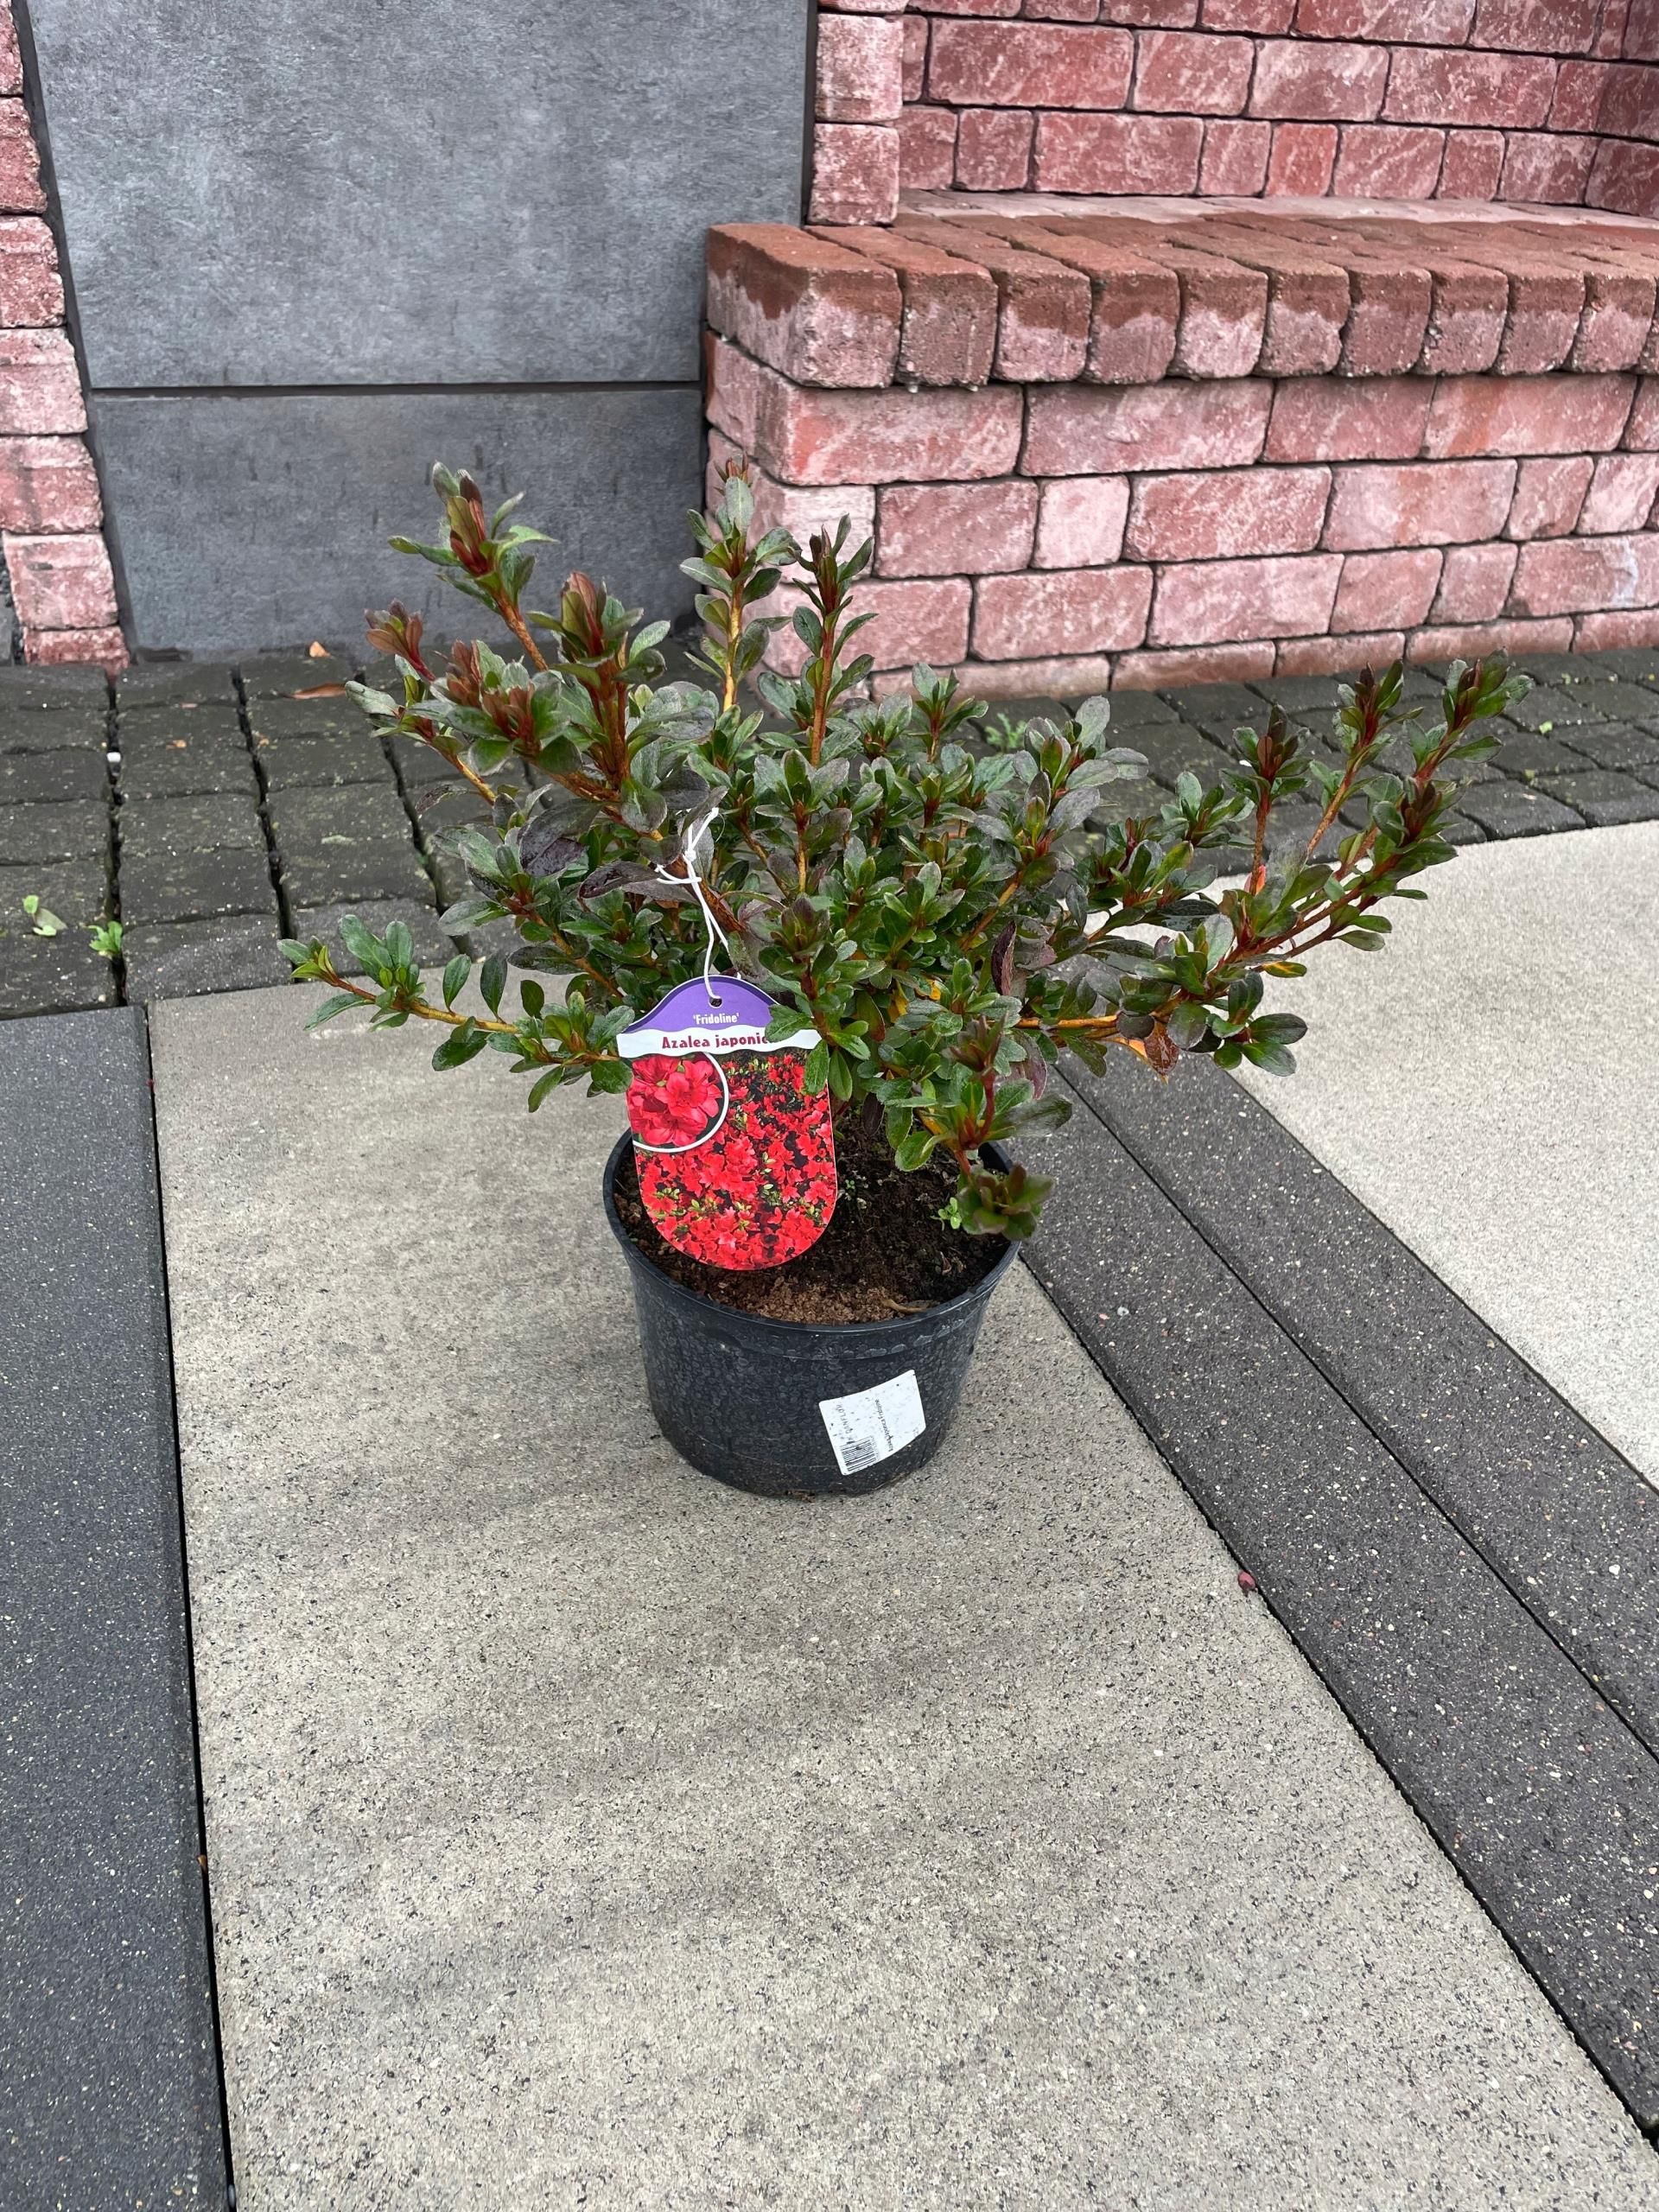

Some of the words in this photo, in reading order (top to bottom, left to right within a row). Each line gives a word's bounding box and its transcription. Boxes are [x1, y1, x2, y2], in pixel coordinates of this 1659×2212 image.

[693, 1013, 740, 1025] 'Fridoline'
[662, 1036, 710, 1049] Azalea
[715, 1033, 769, 1048] japonic
